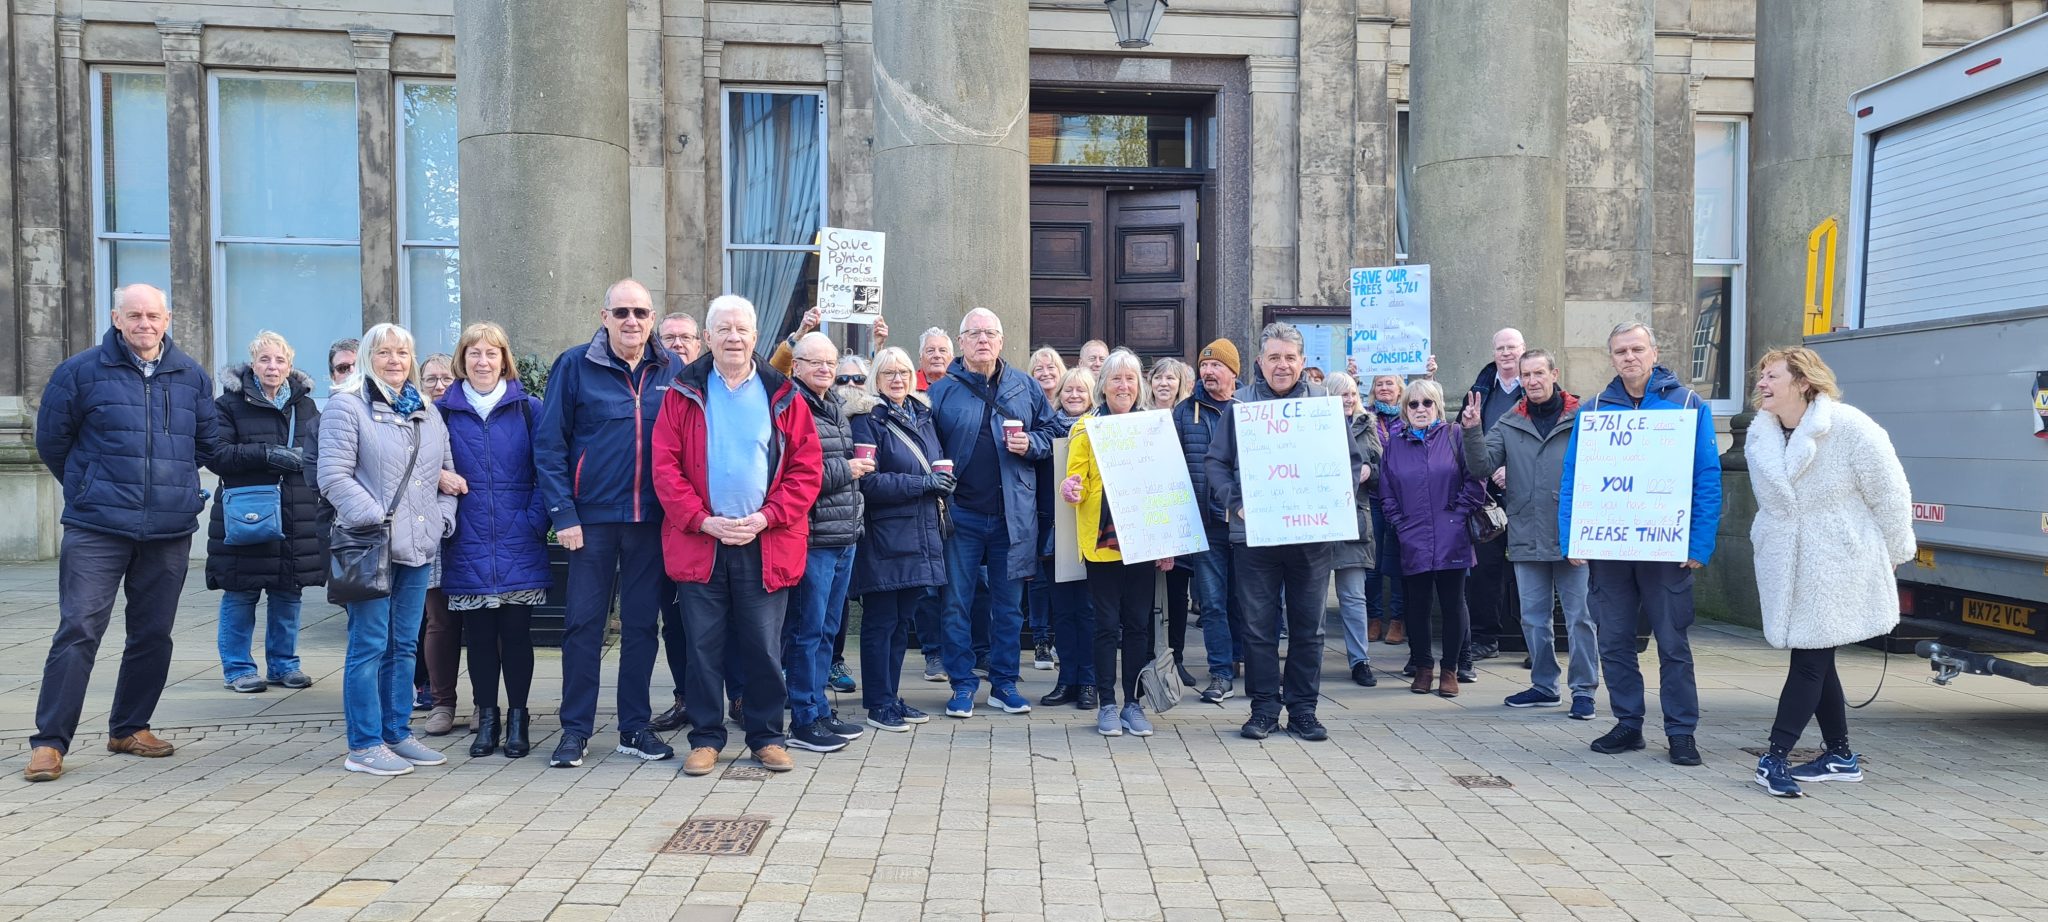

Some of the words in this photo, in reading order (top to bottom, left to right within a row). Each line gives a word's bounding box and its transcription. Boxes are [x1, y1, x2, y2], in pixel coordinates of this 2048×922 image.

[826, 232, 872, 250] Save
[819, 276, 852, 293] Trees
[1353, 270, 1382, 285] SAVE
[1386, 269, 1407, 282] OUR
[1352, 284, 1382, 296] TREES
[1396, 281, 1418, 294] 5,761
[1360, 297, 1378, 307] C.E.
[1353, 330, 1377, 341] YOU
[1371, 351, 1423, 364] CONSIDER
[1240, 404, 1273, 422] 5,761
[1282, 402, 1306, 418] C.E.
[1267, 419, 1289, 434] NO
[1627, 417, 1649, 430] C.E.
[1609, 431, 1632, 446] NO
[1268, 464, 1300, 480] YOU
[1600, 475, 1634, 492] YOU
[1282, 513, 1329, 528] THINK
[1677, 509, 1685, 526] ?
[1580, 525, 1629, 541] PLEASE
[1635, 526, 1684, 542] THINK
[1968, 600, 2001, 623] MX72
